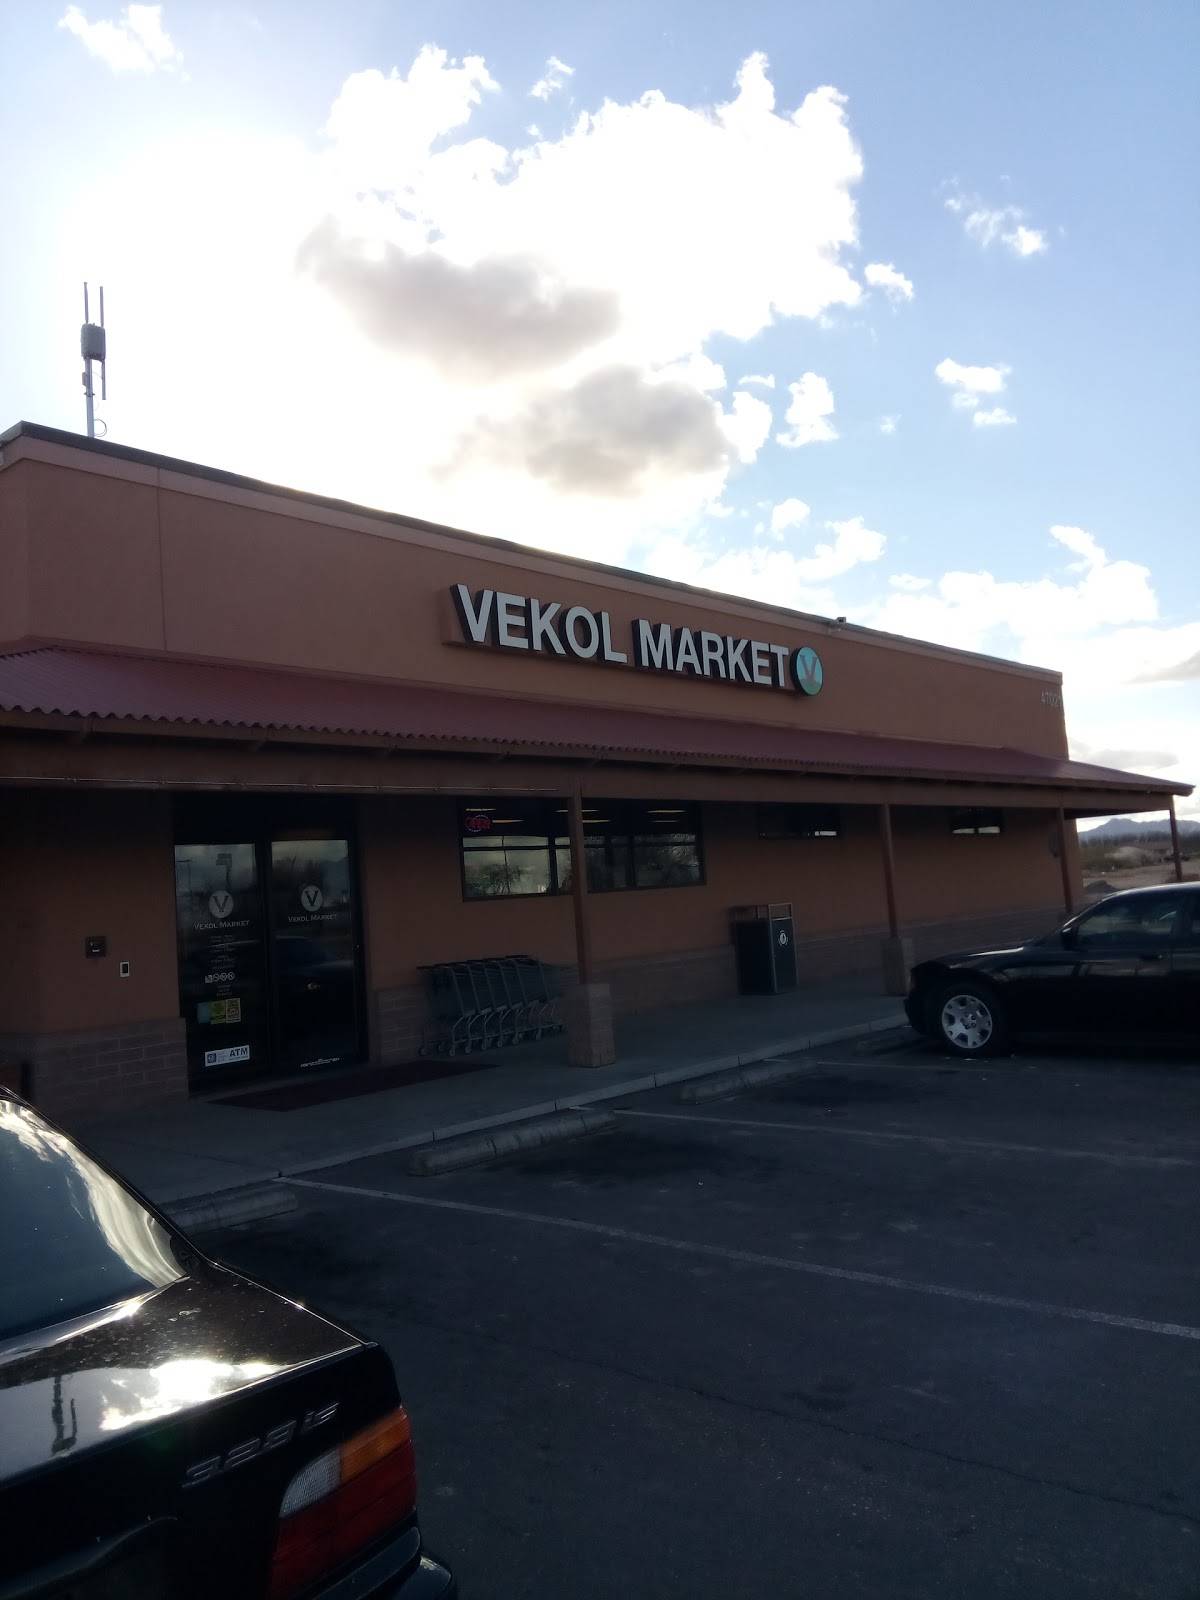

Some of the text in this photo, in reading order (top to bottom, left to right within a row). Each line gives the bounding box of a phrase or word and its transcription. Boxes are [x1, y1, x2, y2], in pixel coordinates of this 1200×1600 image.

[456, 584, 790, 688] VEKOL MARKET
[212, 895, 230, 913] V
[303, 890, 319, 906] V
[229, 1047, 249, 1058] ATM
